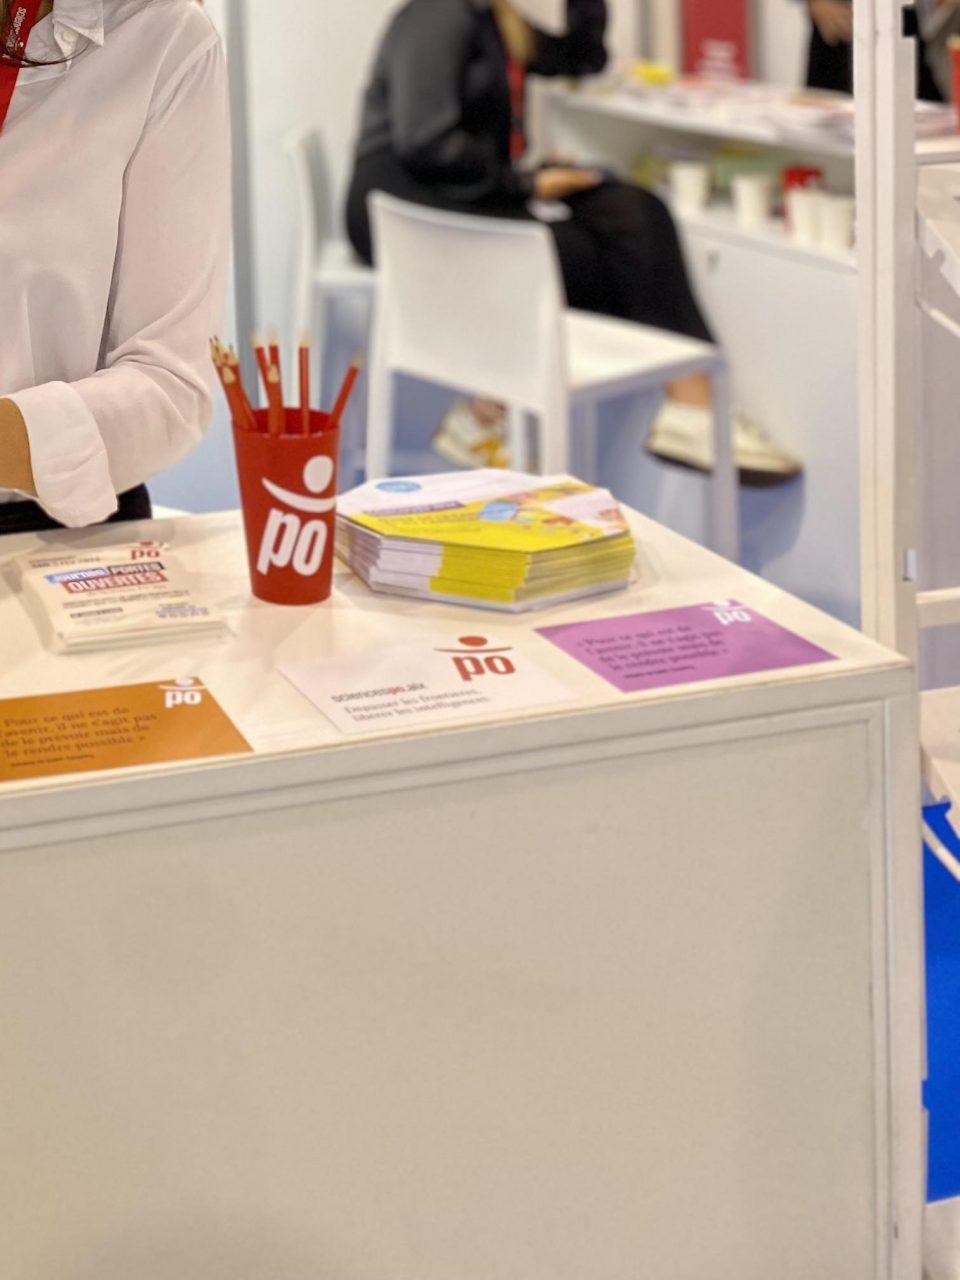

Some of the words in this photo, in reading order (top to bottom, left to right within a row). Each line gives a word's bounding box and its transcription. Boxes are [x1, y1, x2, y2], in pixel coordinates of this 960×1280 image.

[256, 507, 328, 576] po
[131, 549, 161, 561] po
[68, 571, 162, 592] OUVERTES
[715, 608, 753, 626] po
[452, 655, 517, 681] po
[164, 689, 202, 708] po
